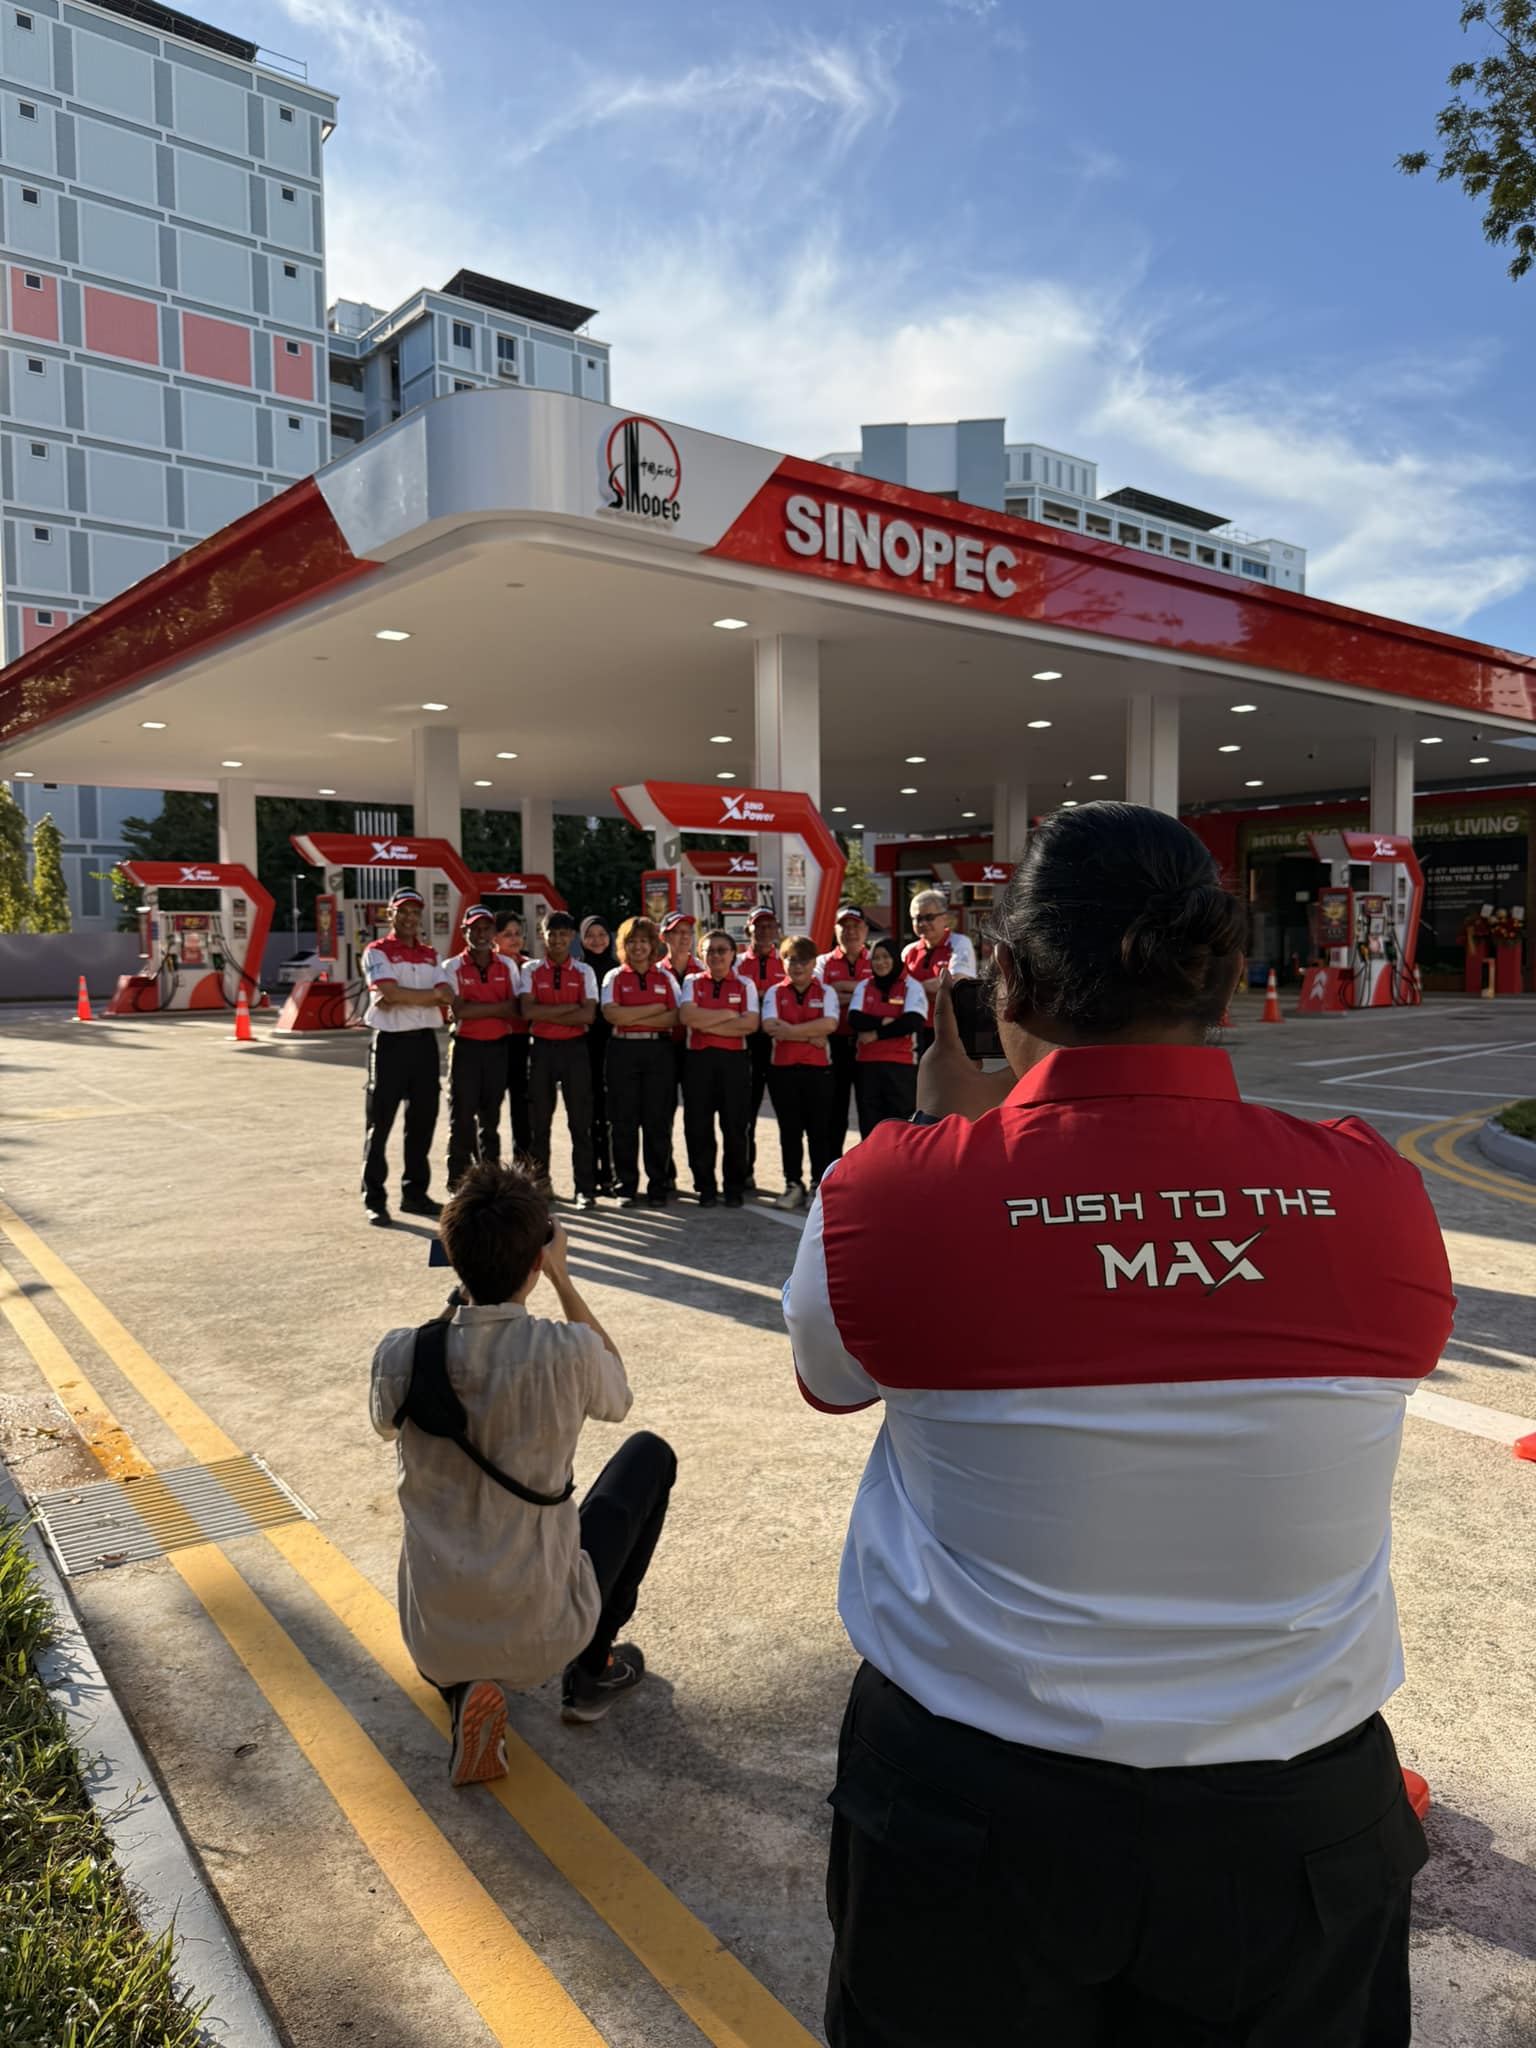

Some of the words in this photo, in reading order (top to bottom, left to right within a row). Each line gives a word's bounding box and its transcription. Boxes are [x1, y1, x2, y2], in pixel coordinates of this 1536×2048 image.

[785, 495, 1017, 598] SINOPEC
[1455, 816, 1519, 836] LIVING
[1005, 1192, 1144, 1226] PUSH
[1158, 1189, 1227, 1219] TO
[1241, 1187, 1337, 1217] THE
[1096, 1226, 1268, 1295] MAX
